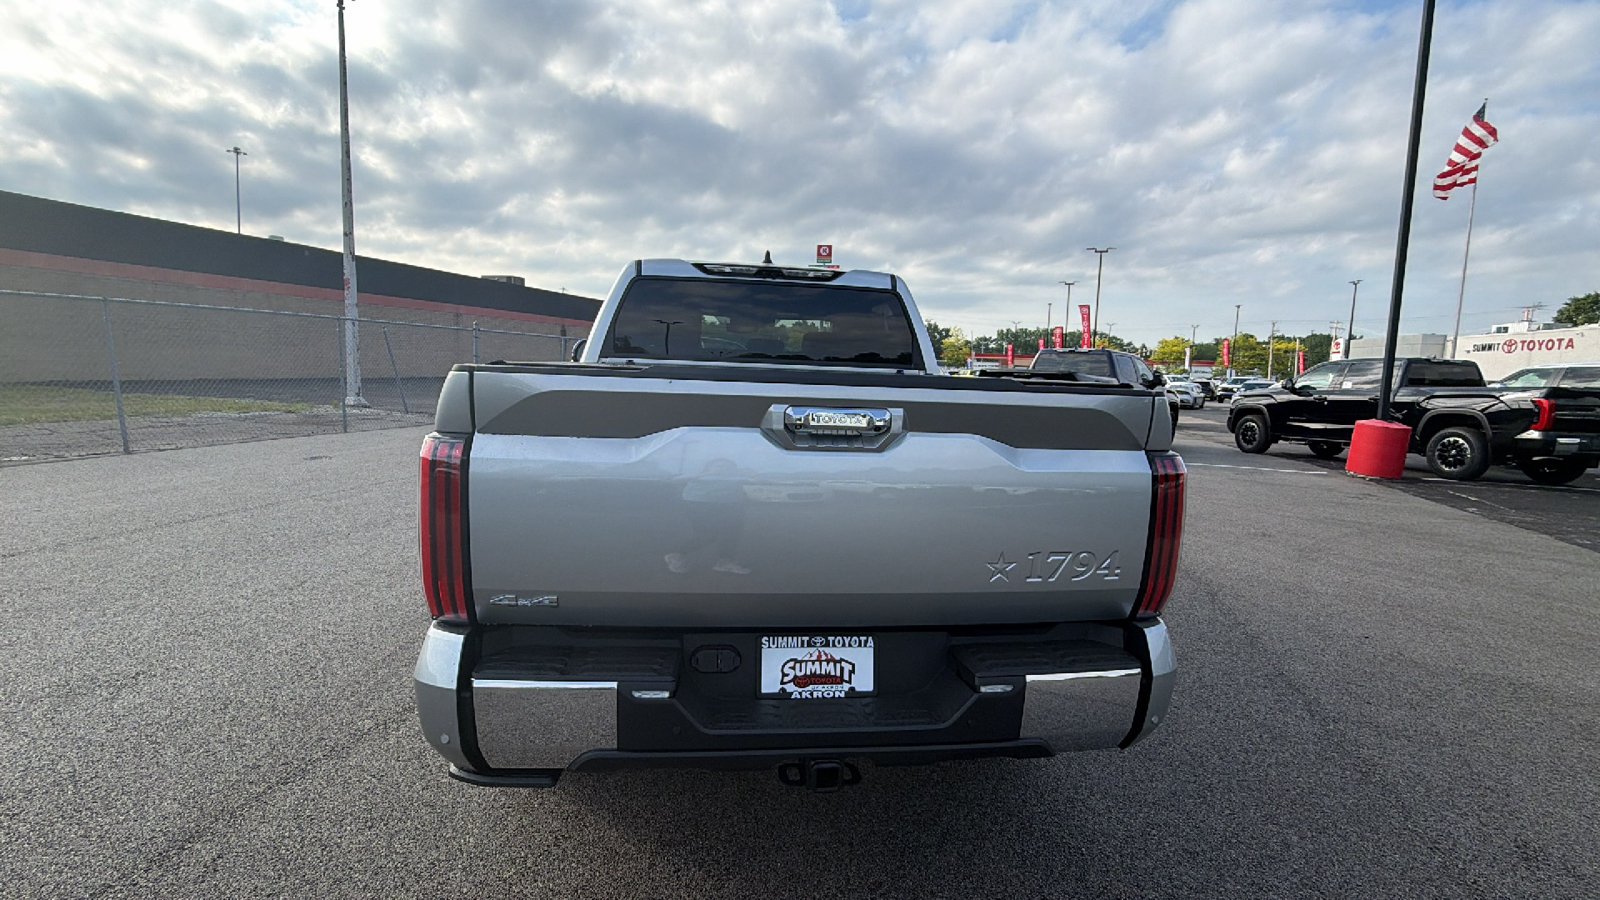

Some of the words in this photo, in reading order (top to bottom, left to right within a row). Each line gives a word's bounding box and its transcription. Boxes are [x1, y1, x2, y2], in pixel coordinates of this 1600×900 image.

[1472, 342, 1501, 352] SUMMIT
[1520, 338, 1574, 351] TOYOTA
[814, 414, 863, 425] TOYOTA
[1026, 550, 1121, 582] 1794
[761, 636, 809, 648] SUMMIT
[828, 636, 874, 647] TOYOTA
[782, 659, 855, 684] SUMMIT
[791, 690, 845, 699] AKRON
